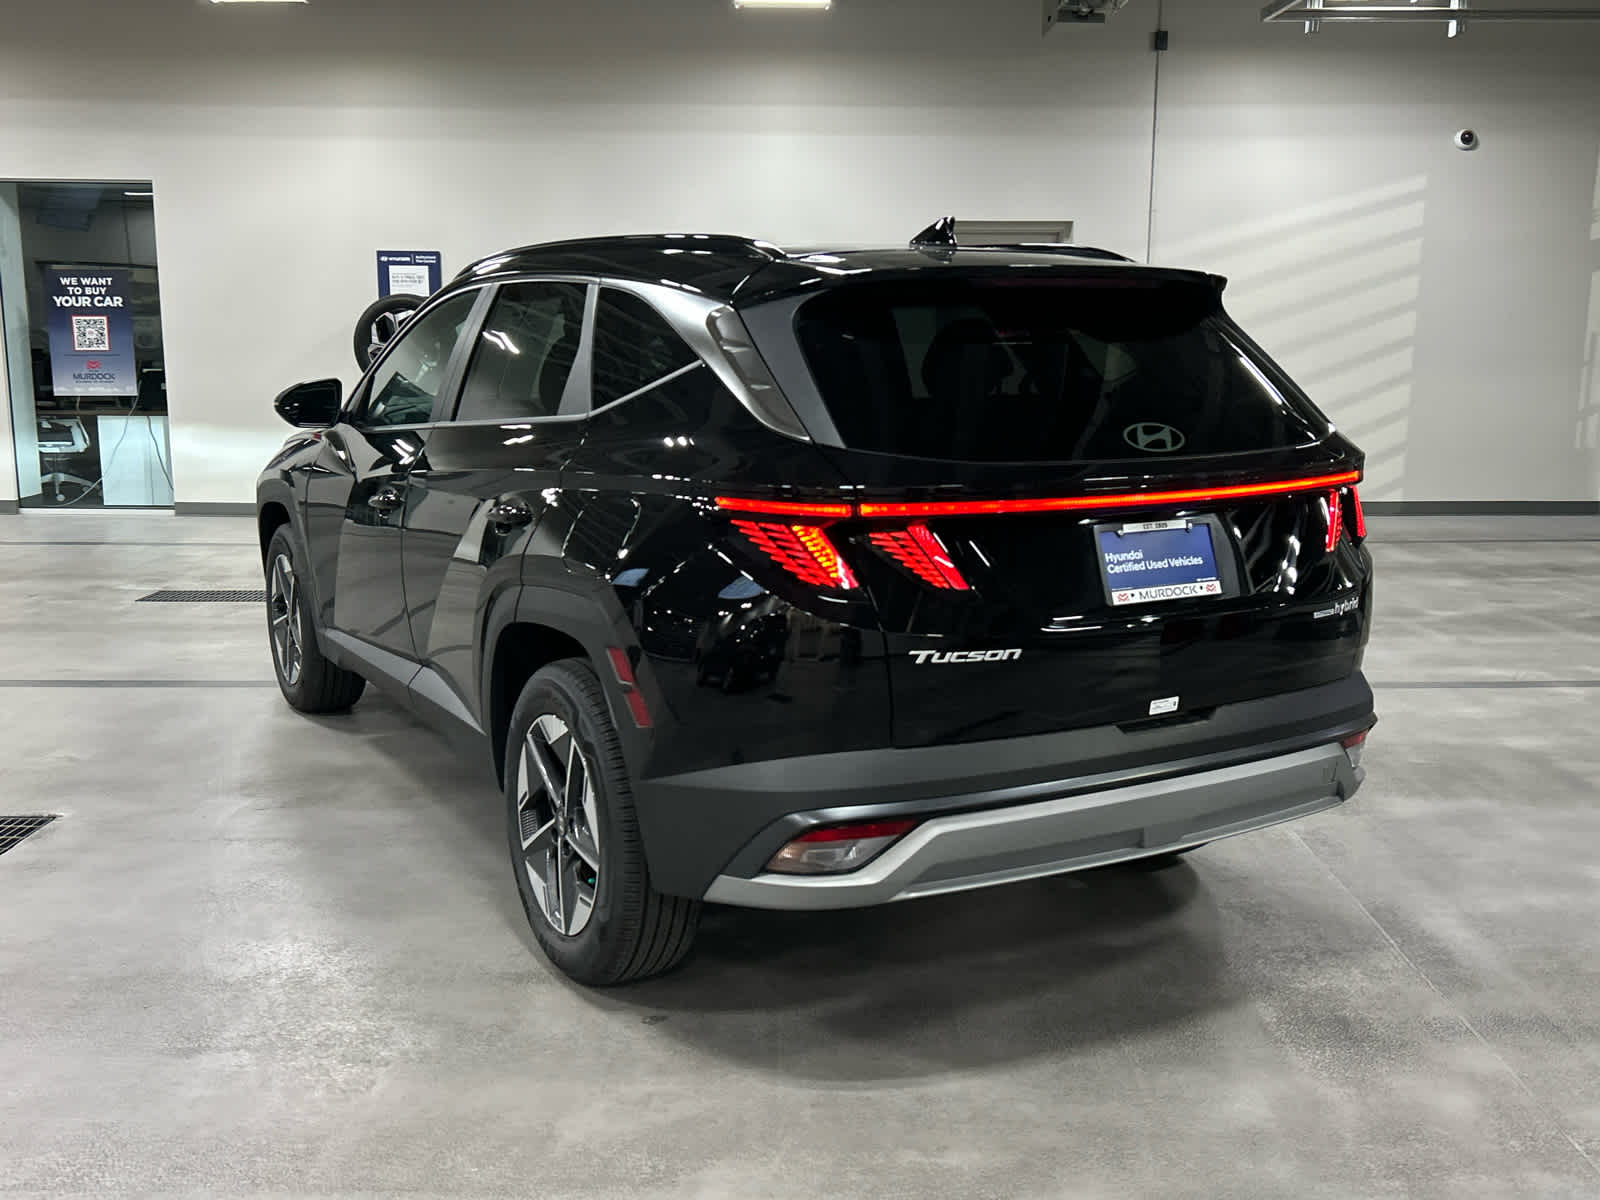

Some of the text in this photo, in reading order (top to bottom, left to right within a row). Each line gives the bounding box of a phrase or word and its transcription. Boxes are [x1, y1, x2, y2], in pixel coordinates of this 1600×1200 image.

[60, 277, 112, 286] WE WANT
[67, 286, 107, 295] TO BUY
[53, 296, 123, 307] YOUR CAR
[1105, 549, 1143, 564] Hyundai
[1107, 556, 1203, 574] Certified Used Vehicles
[1139, 585, 1198, 600] MURDOCK
